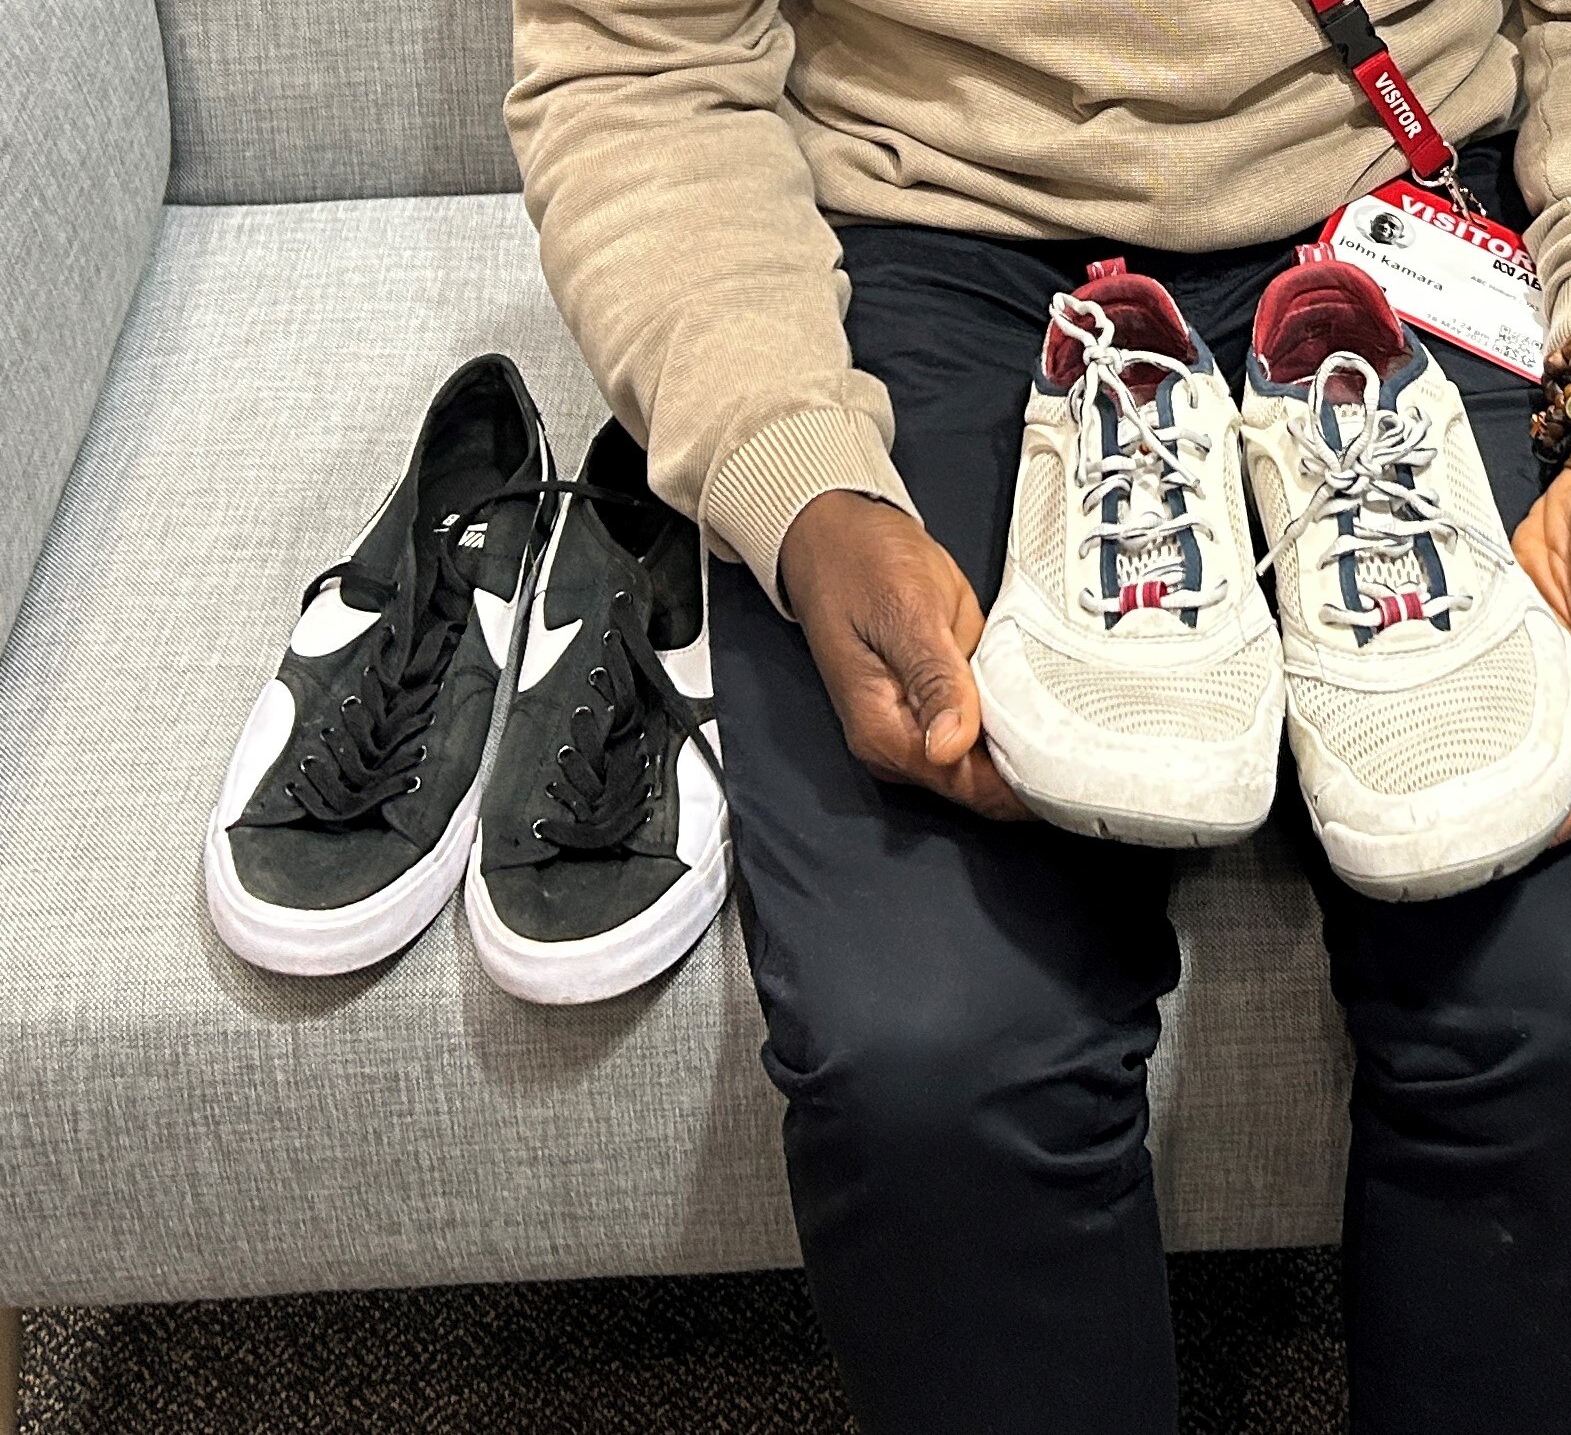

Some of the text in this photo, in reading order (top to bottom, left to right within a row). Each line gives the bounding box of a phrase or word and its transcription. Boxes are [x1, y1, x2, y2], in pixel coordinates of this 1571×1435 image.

[1375, 71, 1422, 140] VISITOR
[1339, 235, 1443, 292] john kamara
[1401, 193, 1535, 272] VISITOR
